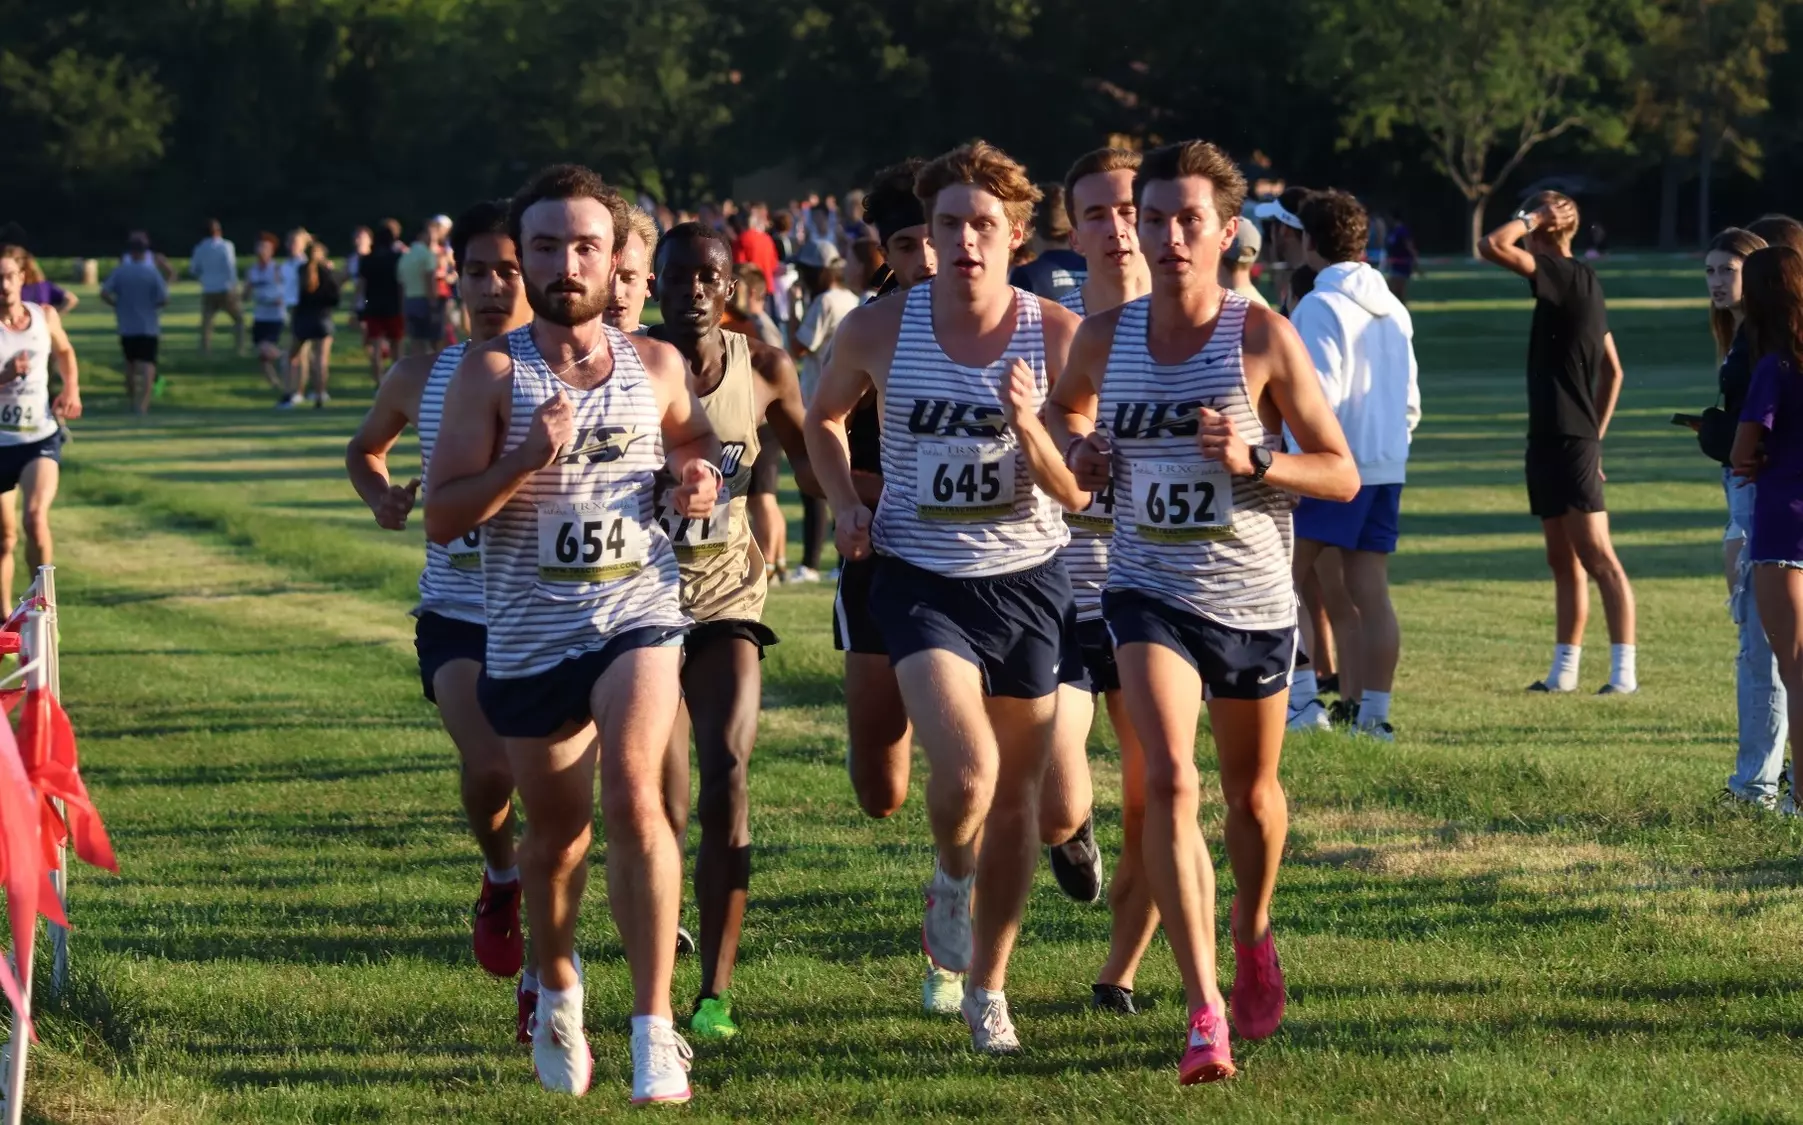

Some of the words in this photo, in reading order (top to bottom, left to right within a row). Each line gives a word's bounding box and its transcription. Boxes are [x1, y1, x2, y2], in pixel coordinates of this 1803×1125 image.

[2, 404, 33, 424] 694
[933, 463, 1000, 503] 645
[1146, 482, 1216, 524] 652
[555, 518, 625, 563] 654
